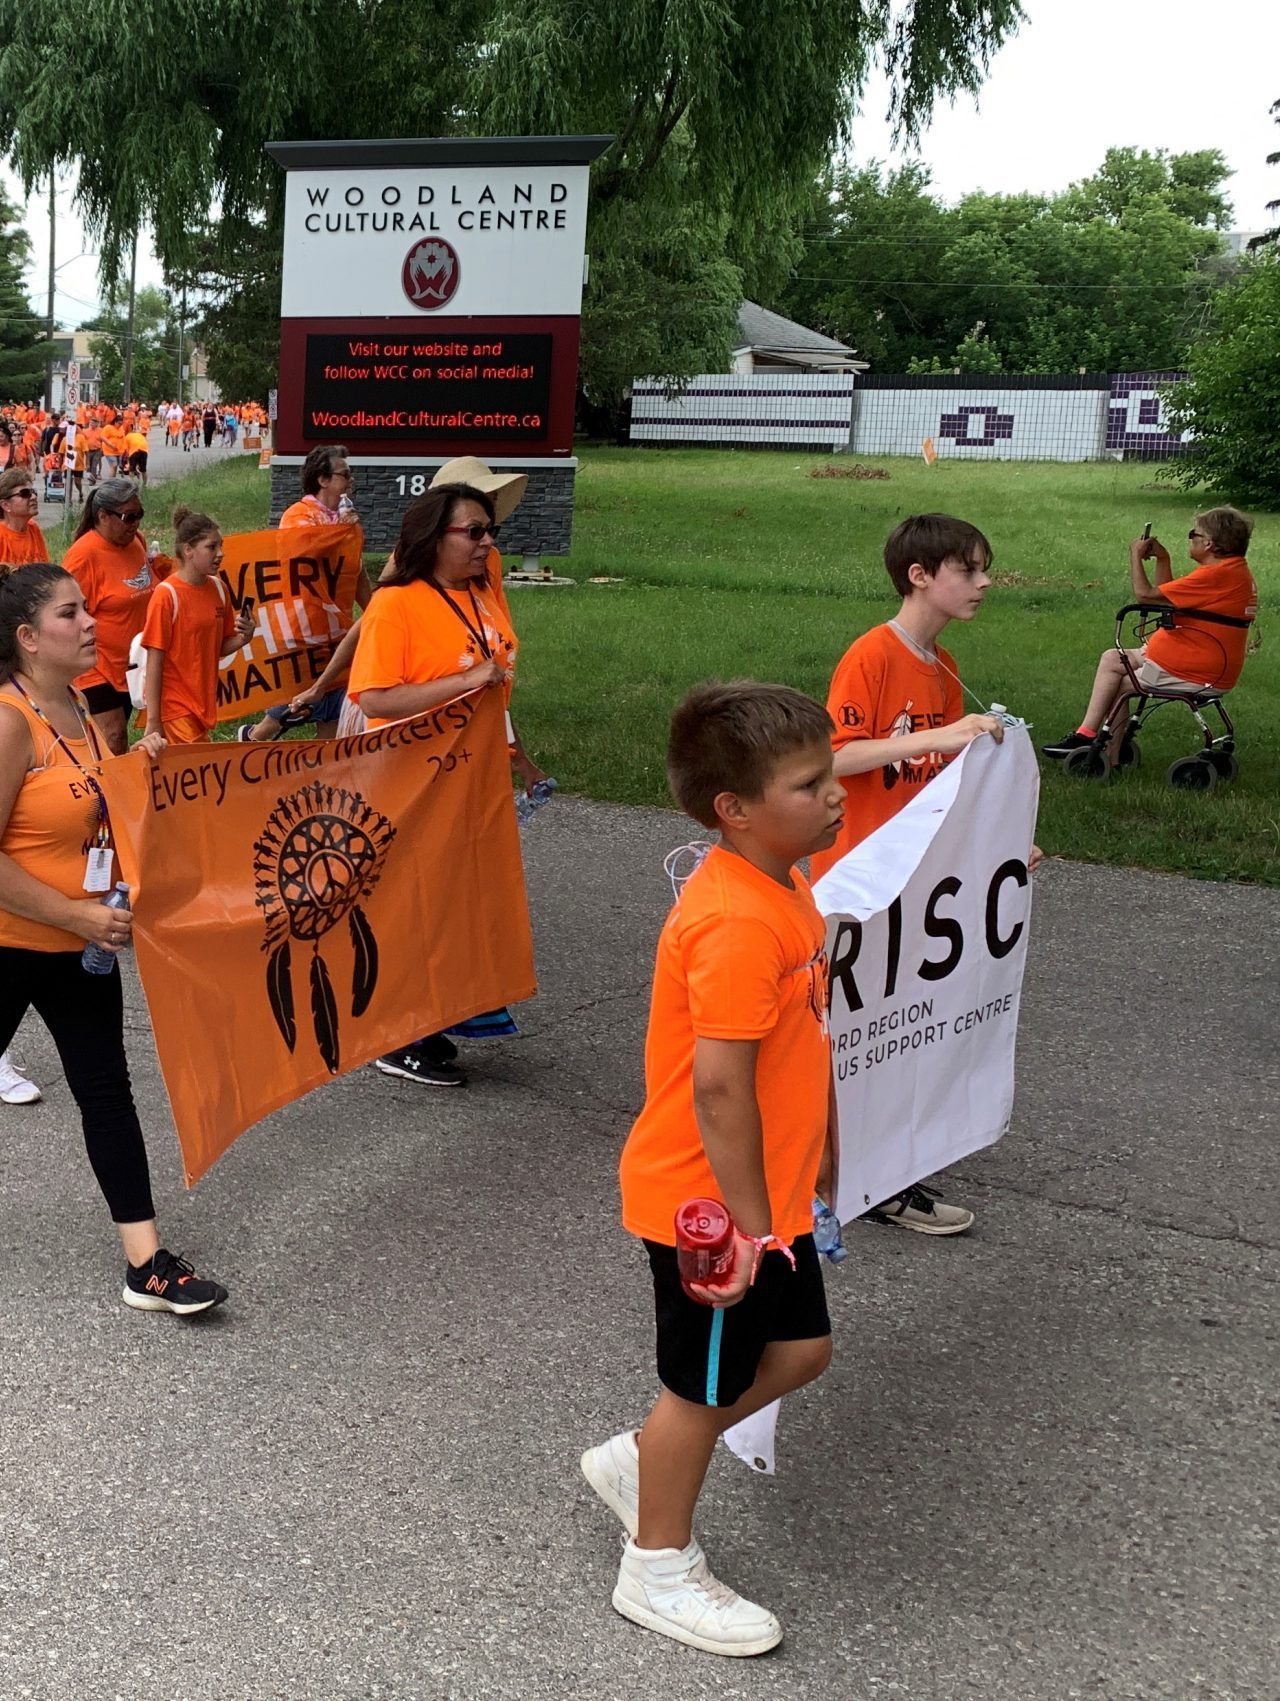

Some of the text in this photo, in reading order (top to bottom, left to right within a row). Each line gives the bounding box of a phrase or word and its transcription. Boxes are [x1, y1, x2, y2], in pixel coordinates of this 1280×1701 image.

[306, 183, 568, 207] WOODLAND
[305, 209, 567, 232] CULTURAL CENTRE
[349, 342, 502, 356] Visit our website and
[324, 365, 534, 379] follow WCC on social media!
[312, 411, 541, 427] WoodlandCulturalCentre.ca
[219, 556, 346, 612] VERY
[150, 757, 232, 813] Every
[865, 1020, 948, 1069] SUPPORT
[953, 993, 1013, 1035] CENTRE
[867, 998, 934, 1041] REGION
